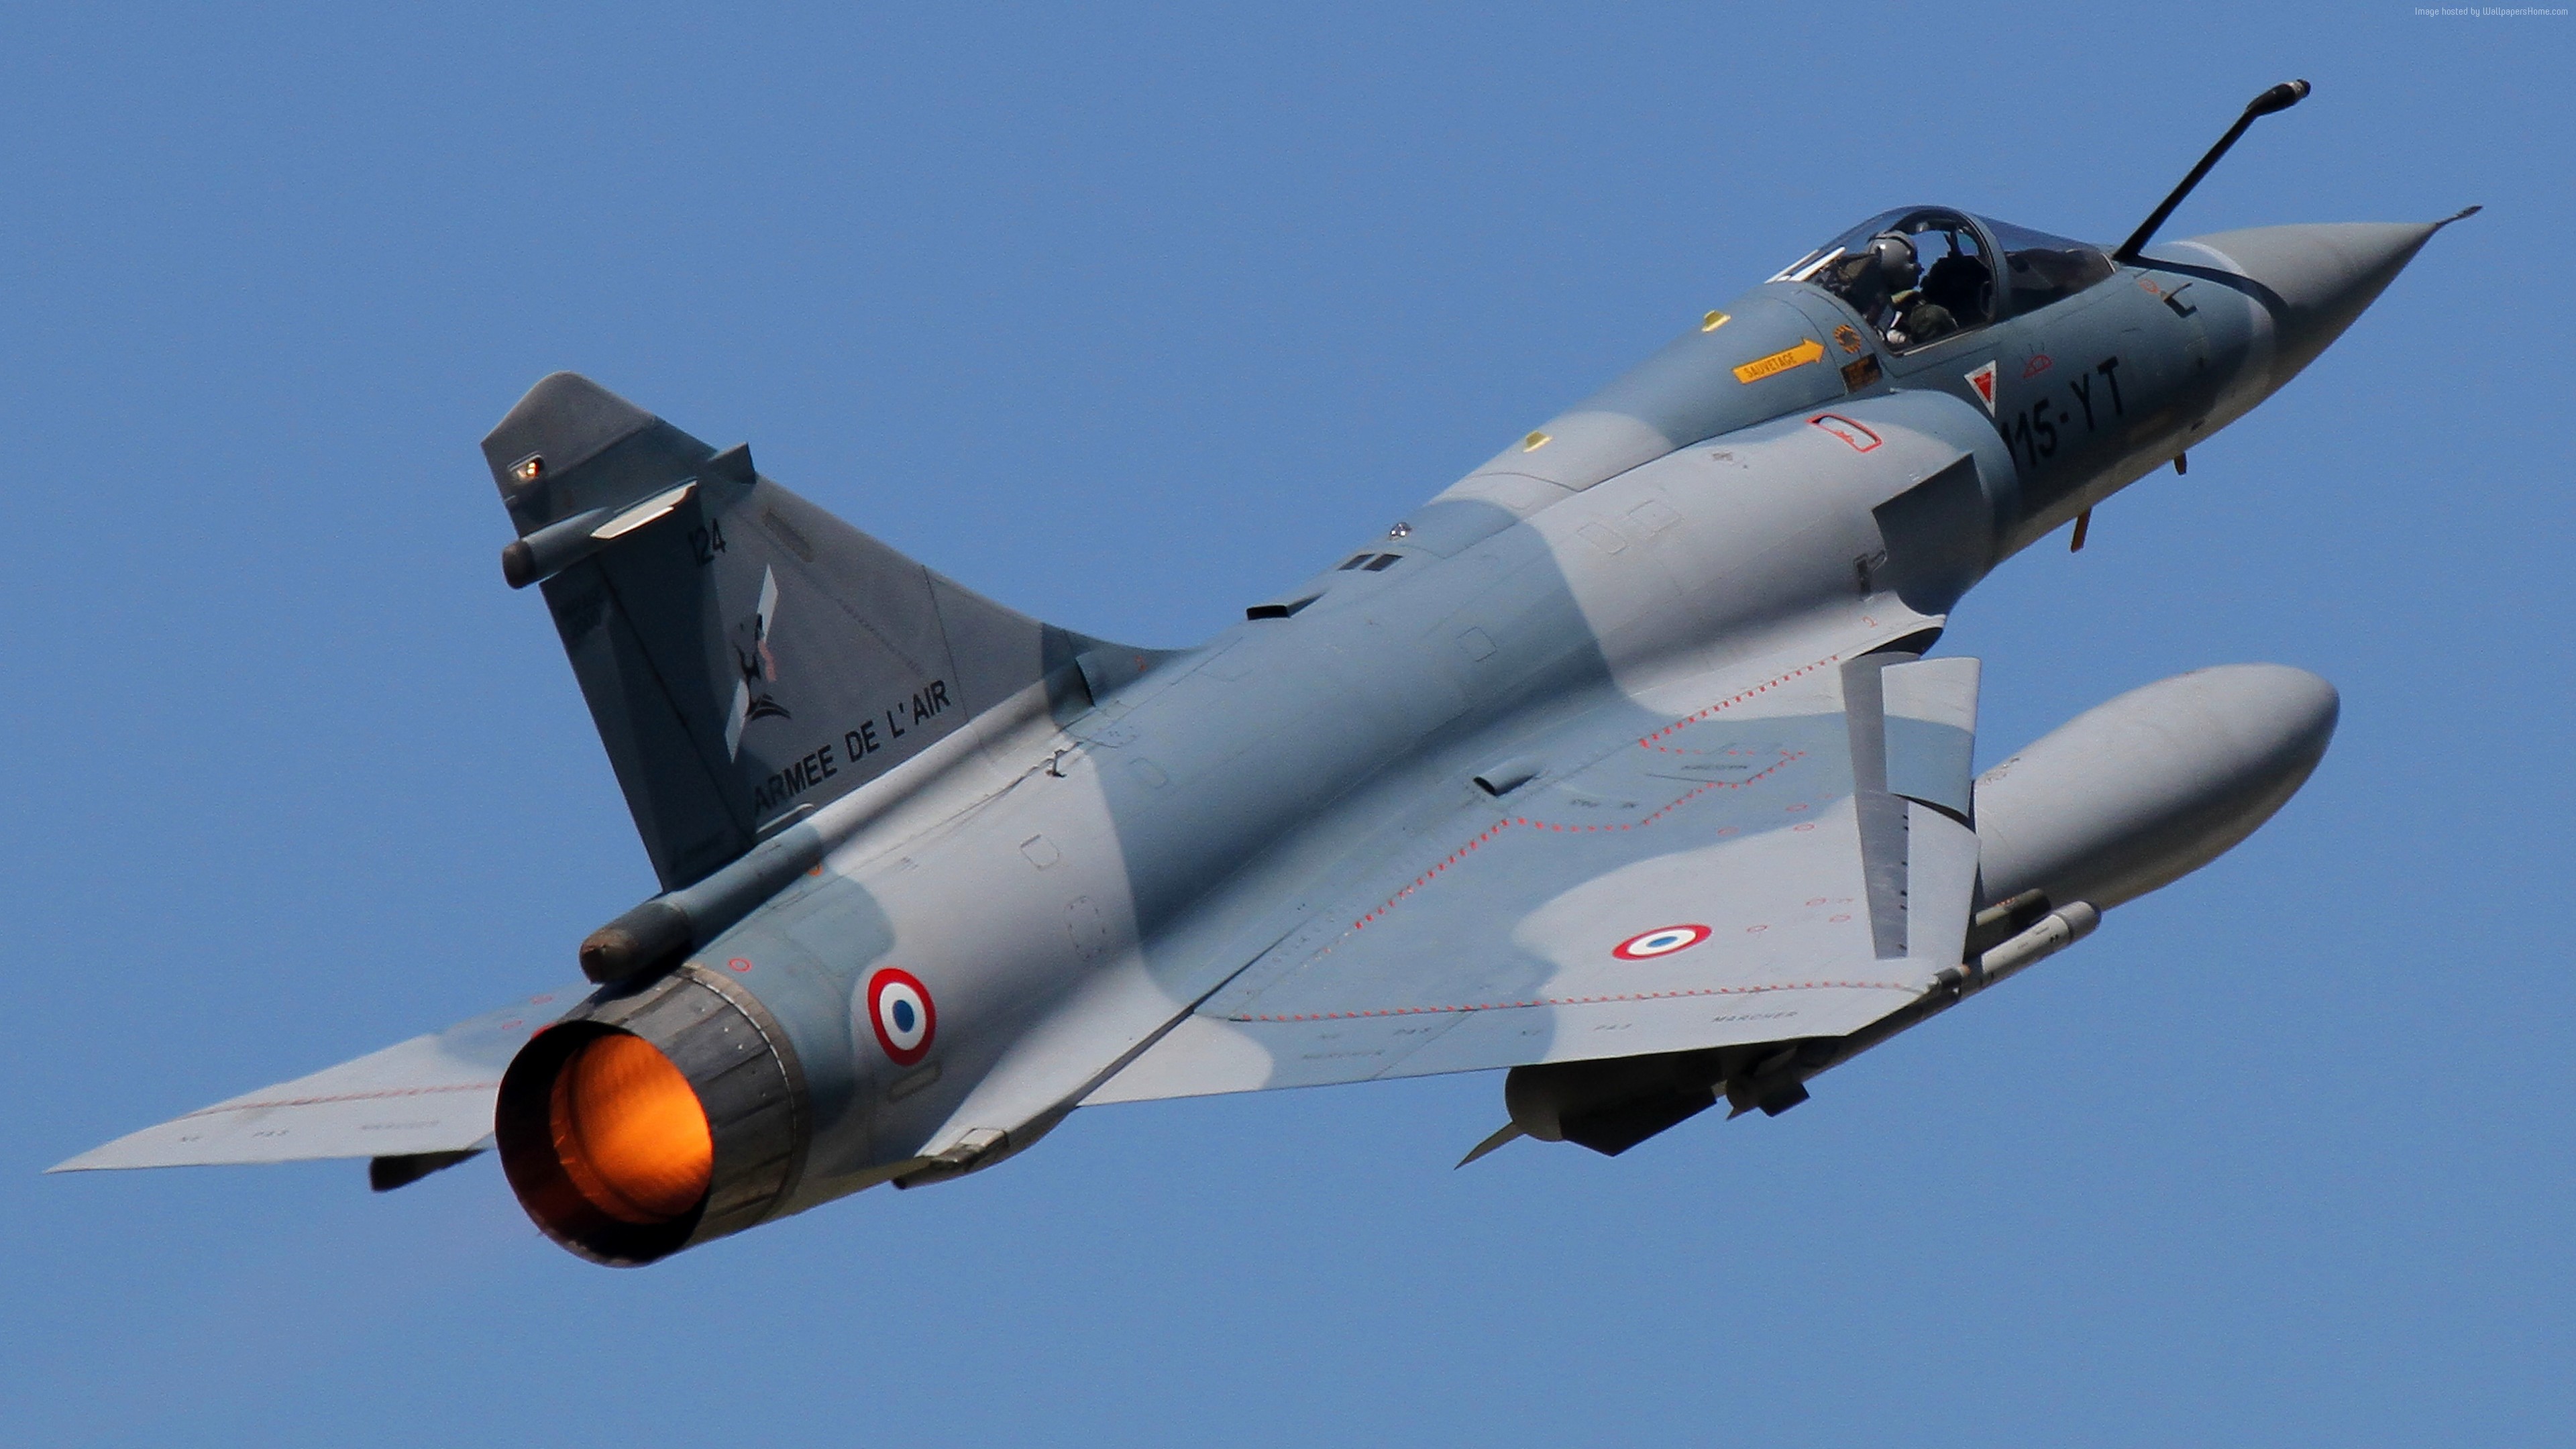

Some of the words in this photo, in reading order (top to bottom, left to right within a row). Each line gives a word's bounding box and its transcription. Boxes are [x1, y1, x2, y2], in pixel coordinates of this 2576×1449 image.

[1745, 352, 1798, 378] SAUVETAGE
[688, 518, 726, 567] 124
[753, 745, 838, 816] ARMEE
[844, 720, 880, 763] DE
